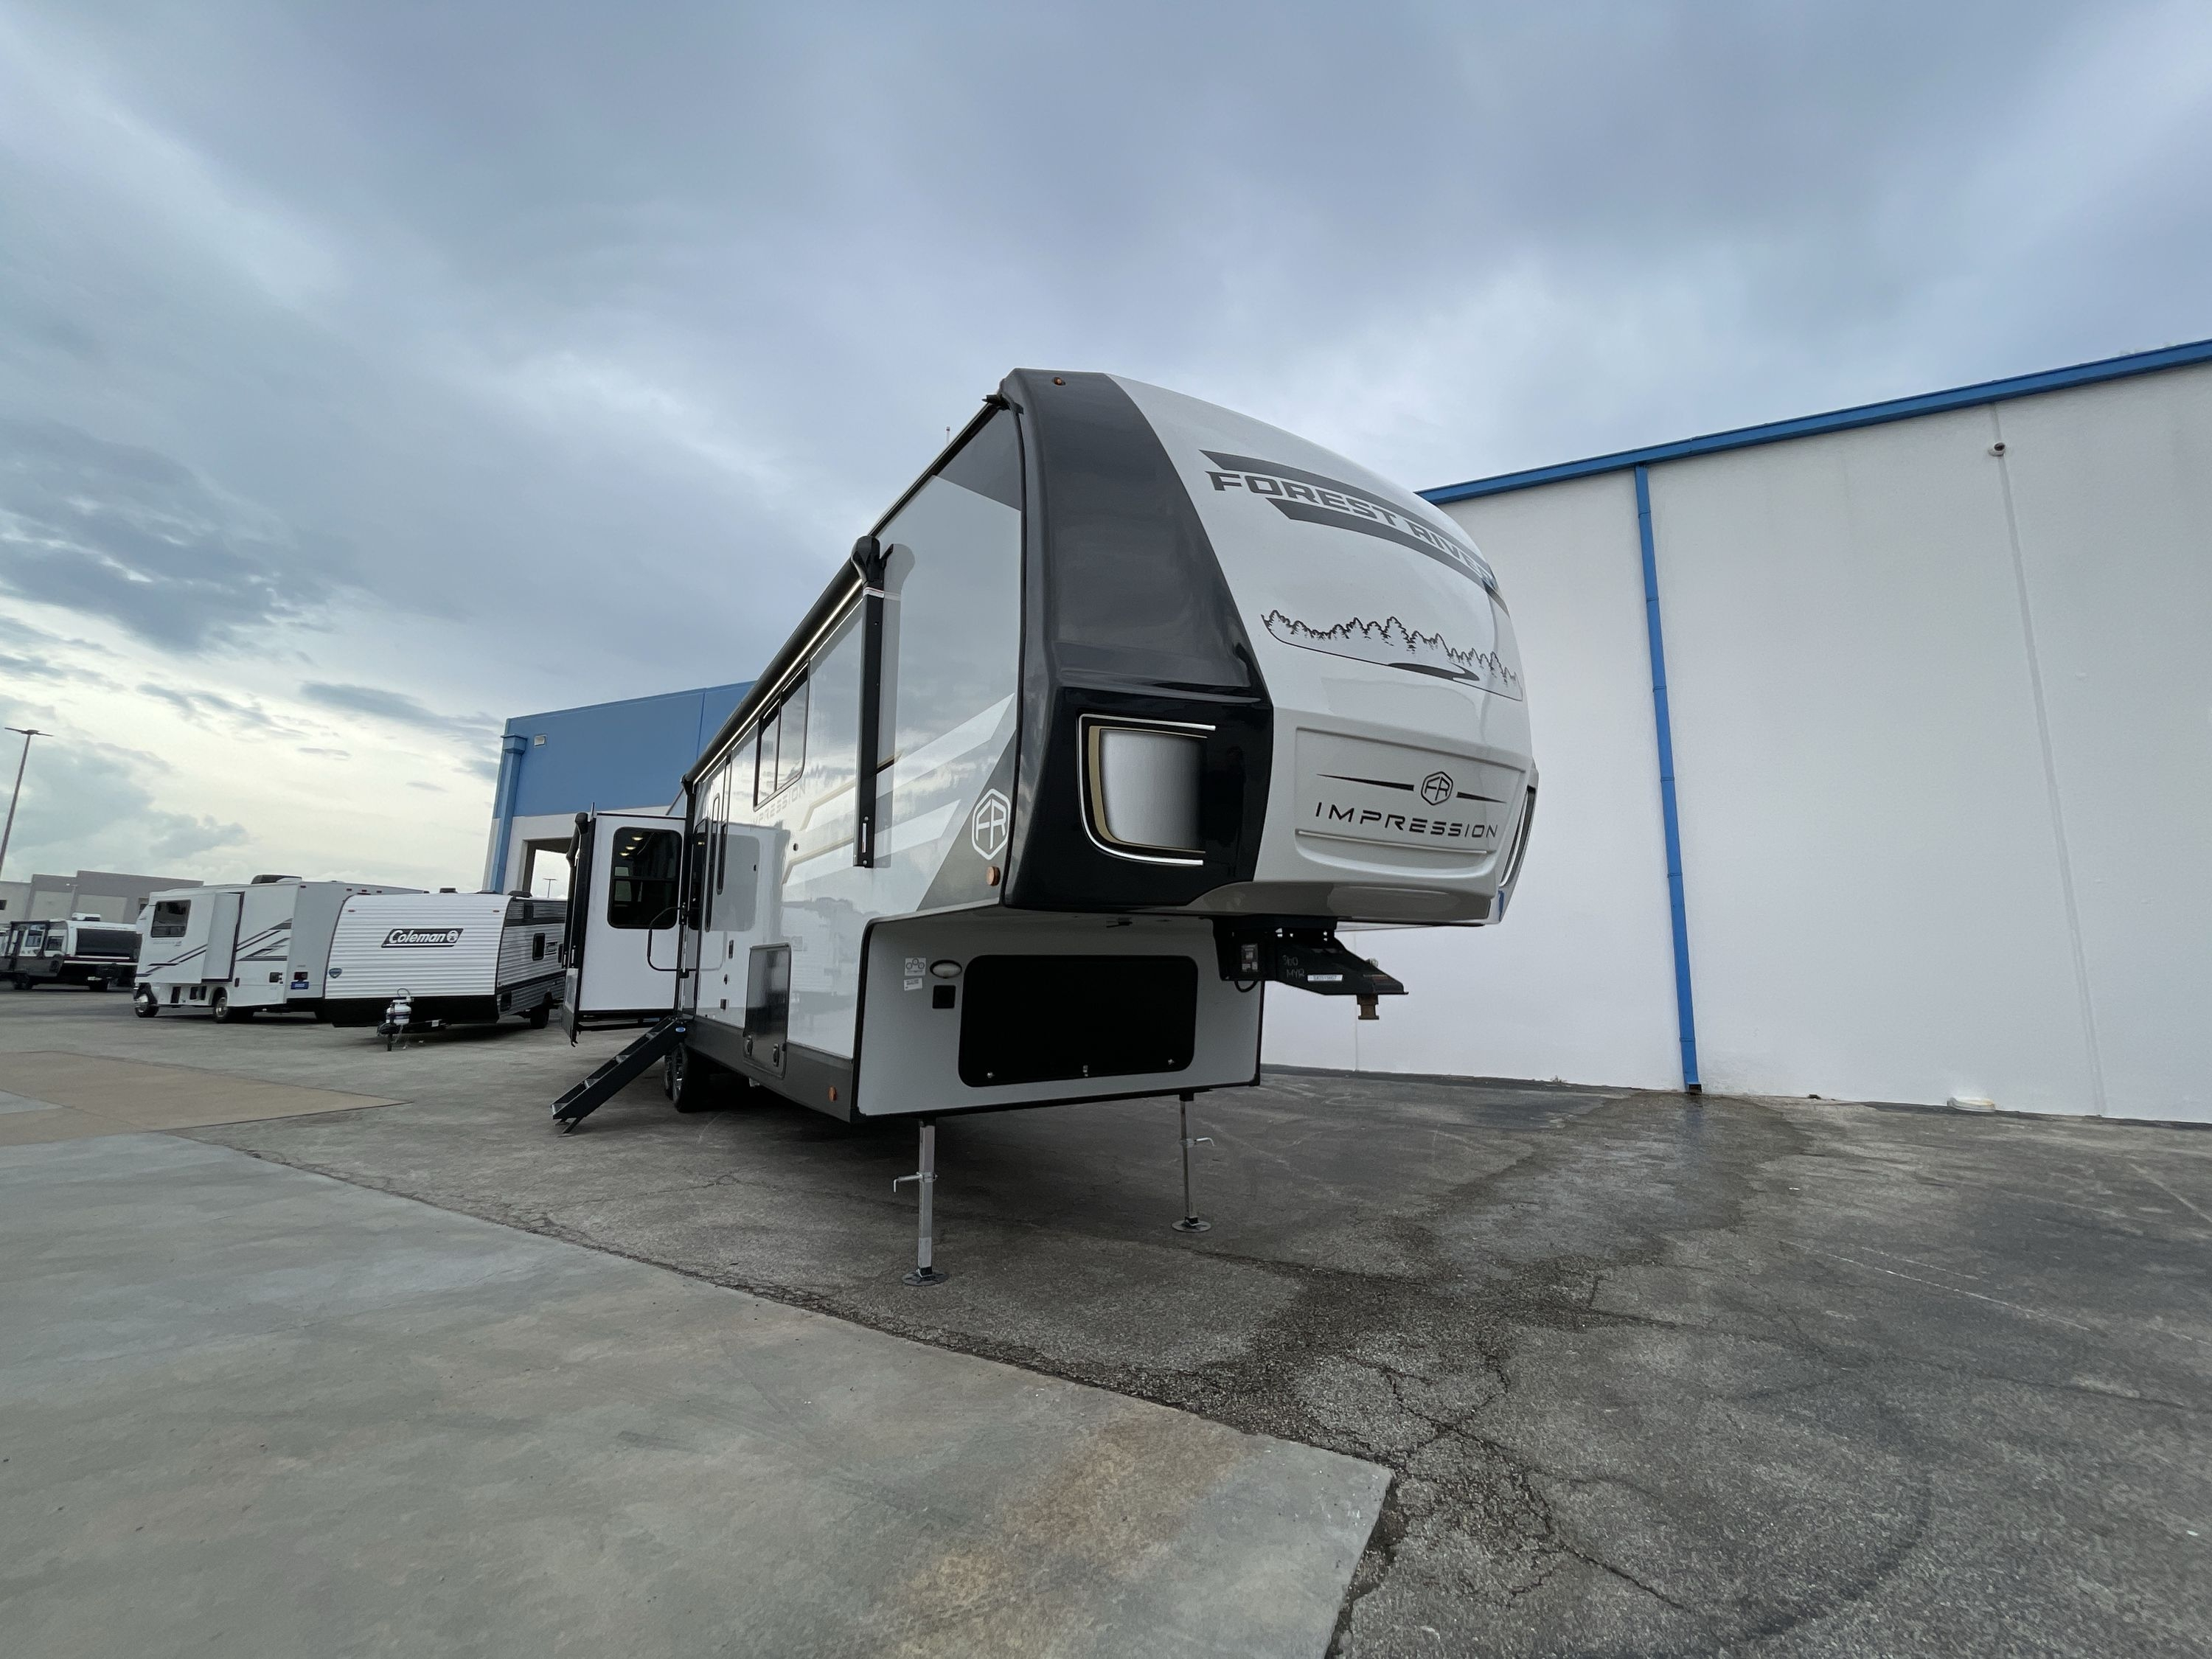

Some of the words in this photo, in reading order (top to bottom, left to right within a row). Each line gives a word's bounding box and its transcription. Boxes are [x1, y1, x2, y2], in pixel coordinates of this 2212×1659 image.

[1206, 471, 1397, 526] FOREST
[1315, 802, 1498, 838] IMPRESSION
[389, 930, 446, 943] Coleman
